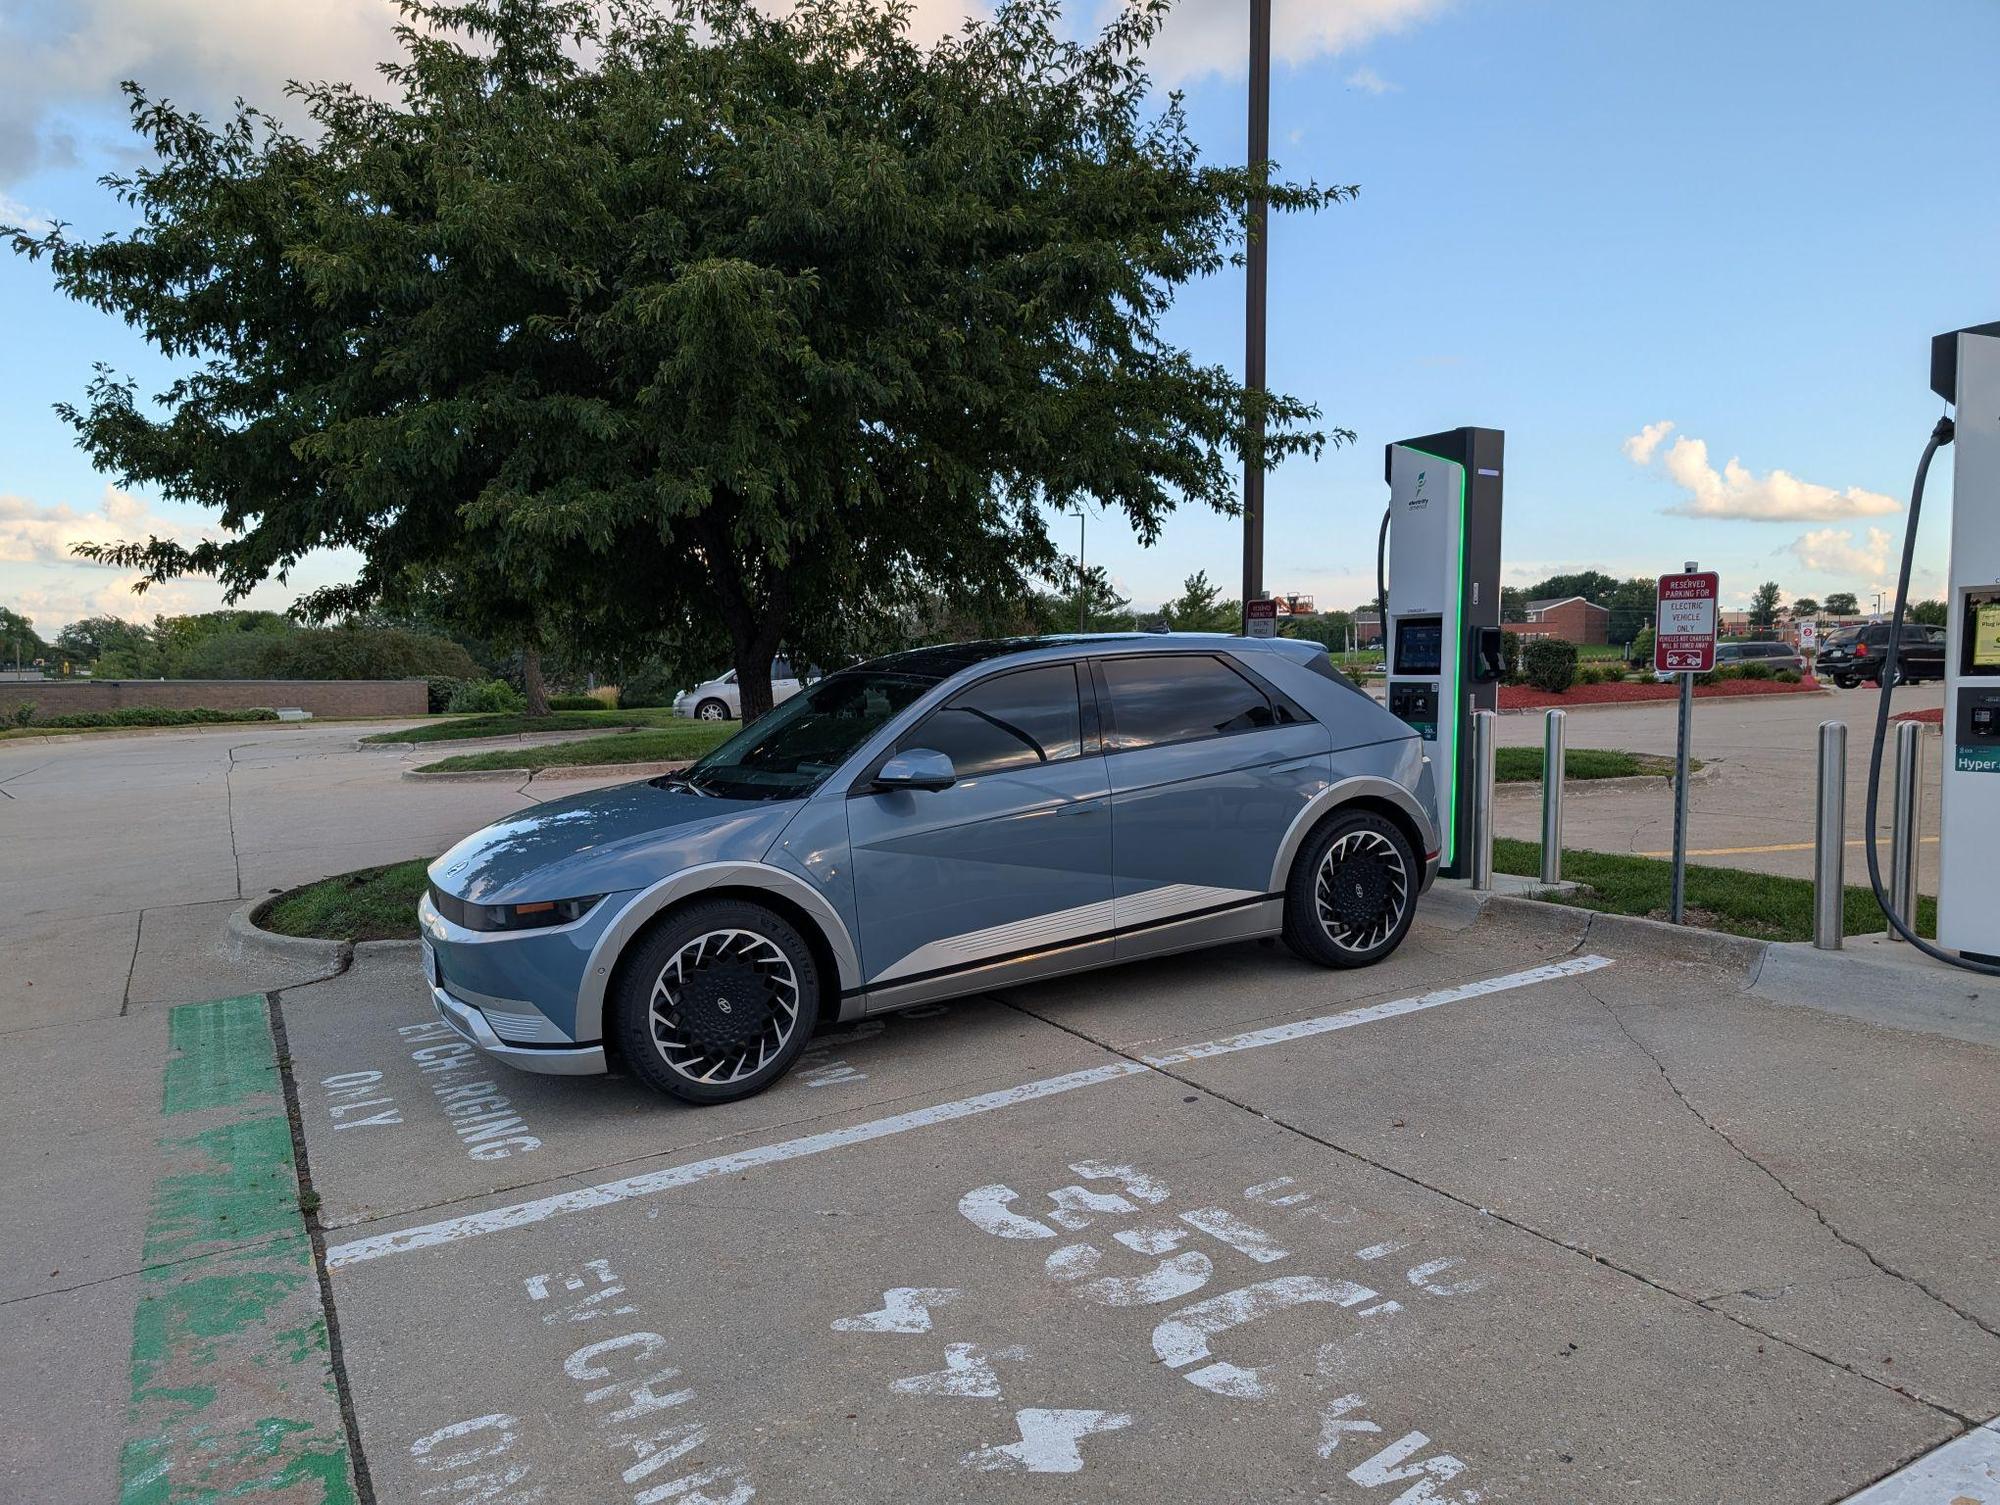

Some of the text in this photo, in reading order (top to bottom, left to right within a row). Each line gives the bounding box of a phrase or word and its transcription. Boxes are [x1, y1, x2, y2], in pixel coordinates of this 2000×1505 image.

[1670, 580, 1706, 590] RESERVED
[1665, 589, 1710, 598] PARKING FOR
[1671, 602, 1704, 610] ELECTRIC
[1672, 613, 1701, 621] VEHICLE
[1676, 624, 1696, 633] ONLY
[320, 1069, 405, 1130] ONLY
[412, 1042, 543, 1161] CHARGING
[958, 1158, 1405, 1402] 350
